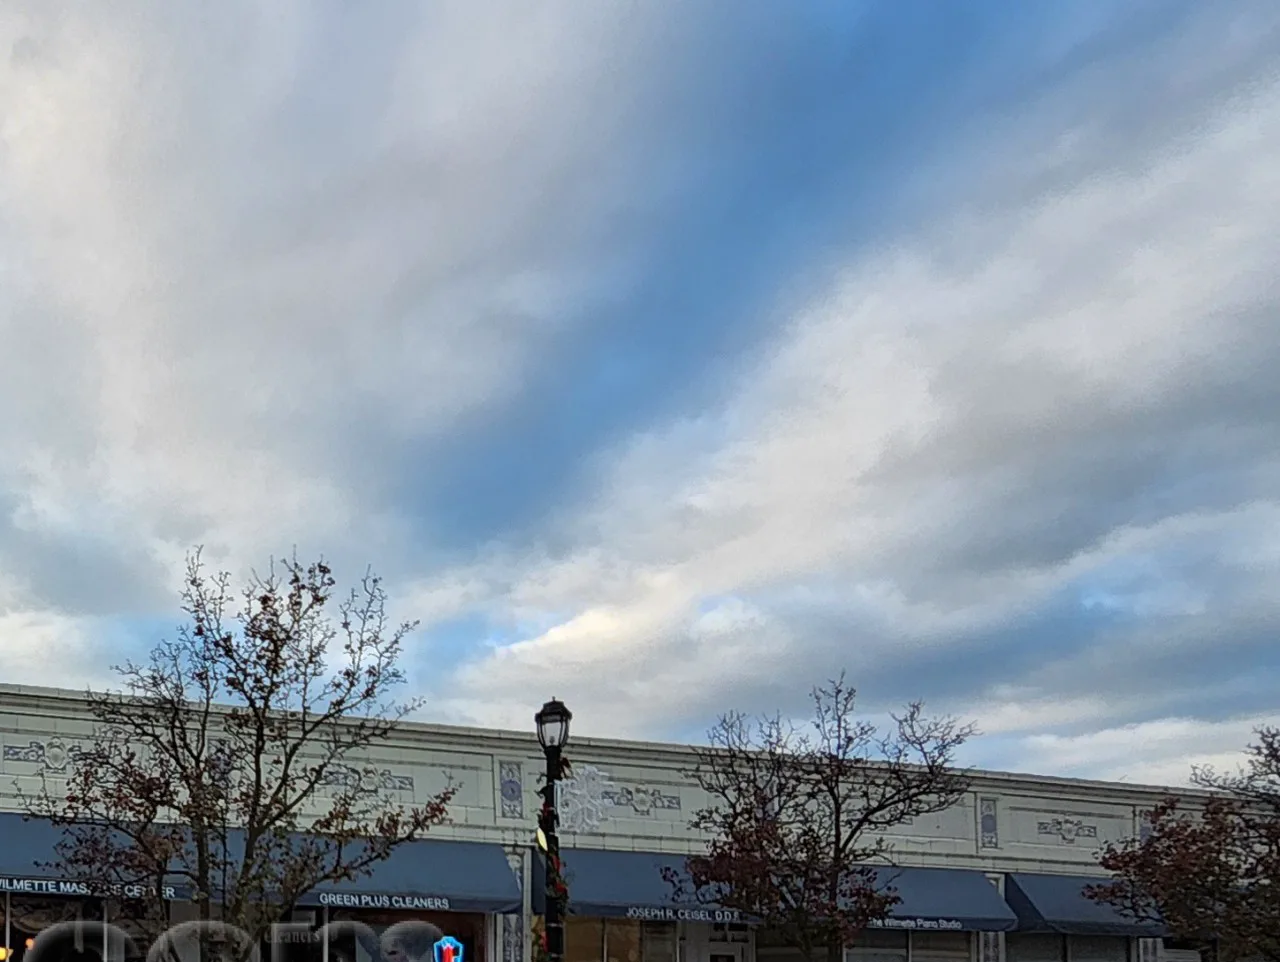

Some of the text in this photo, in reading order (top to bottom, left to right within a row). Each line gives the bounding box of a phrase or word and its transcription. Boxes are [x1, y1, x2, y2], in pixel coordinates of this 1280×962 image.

[320, 893, 450, 910] GREEN PLUS CLEANERS
[626, 907, 664, 920] JOSEPH
[678, 909, 712, 920] CEISEL
[916, 918, 938, 928] Piano
[938, 918, 962, 930] Studio
